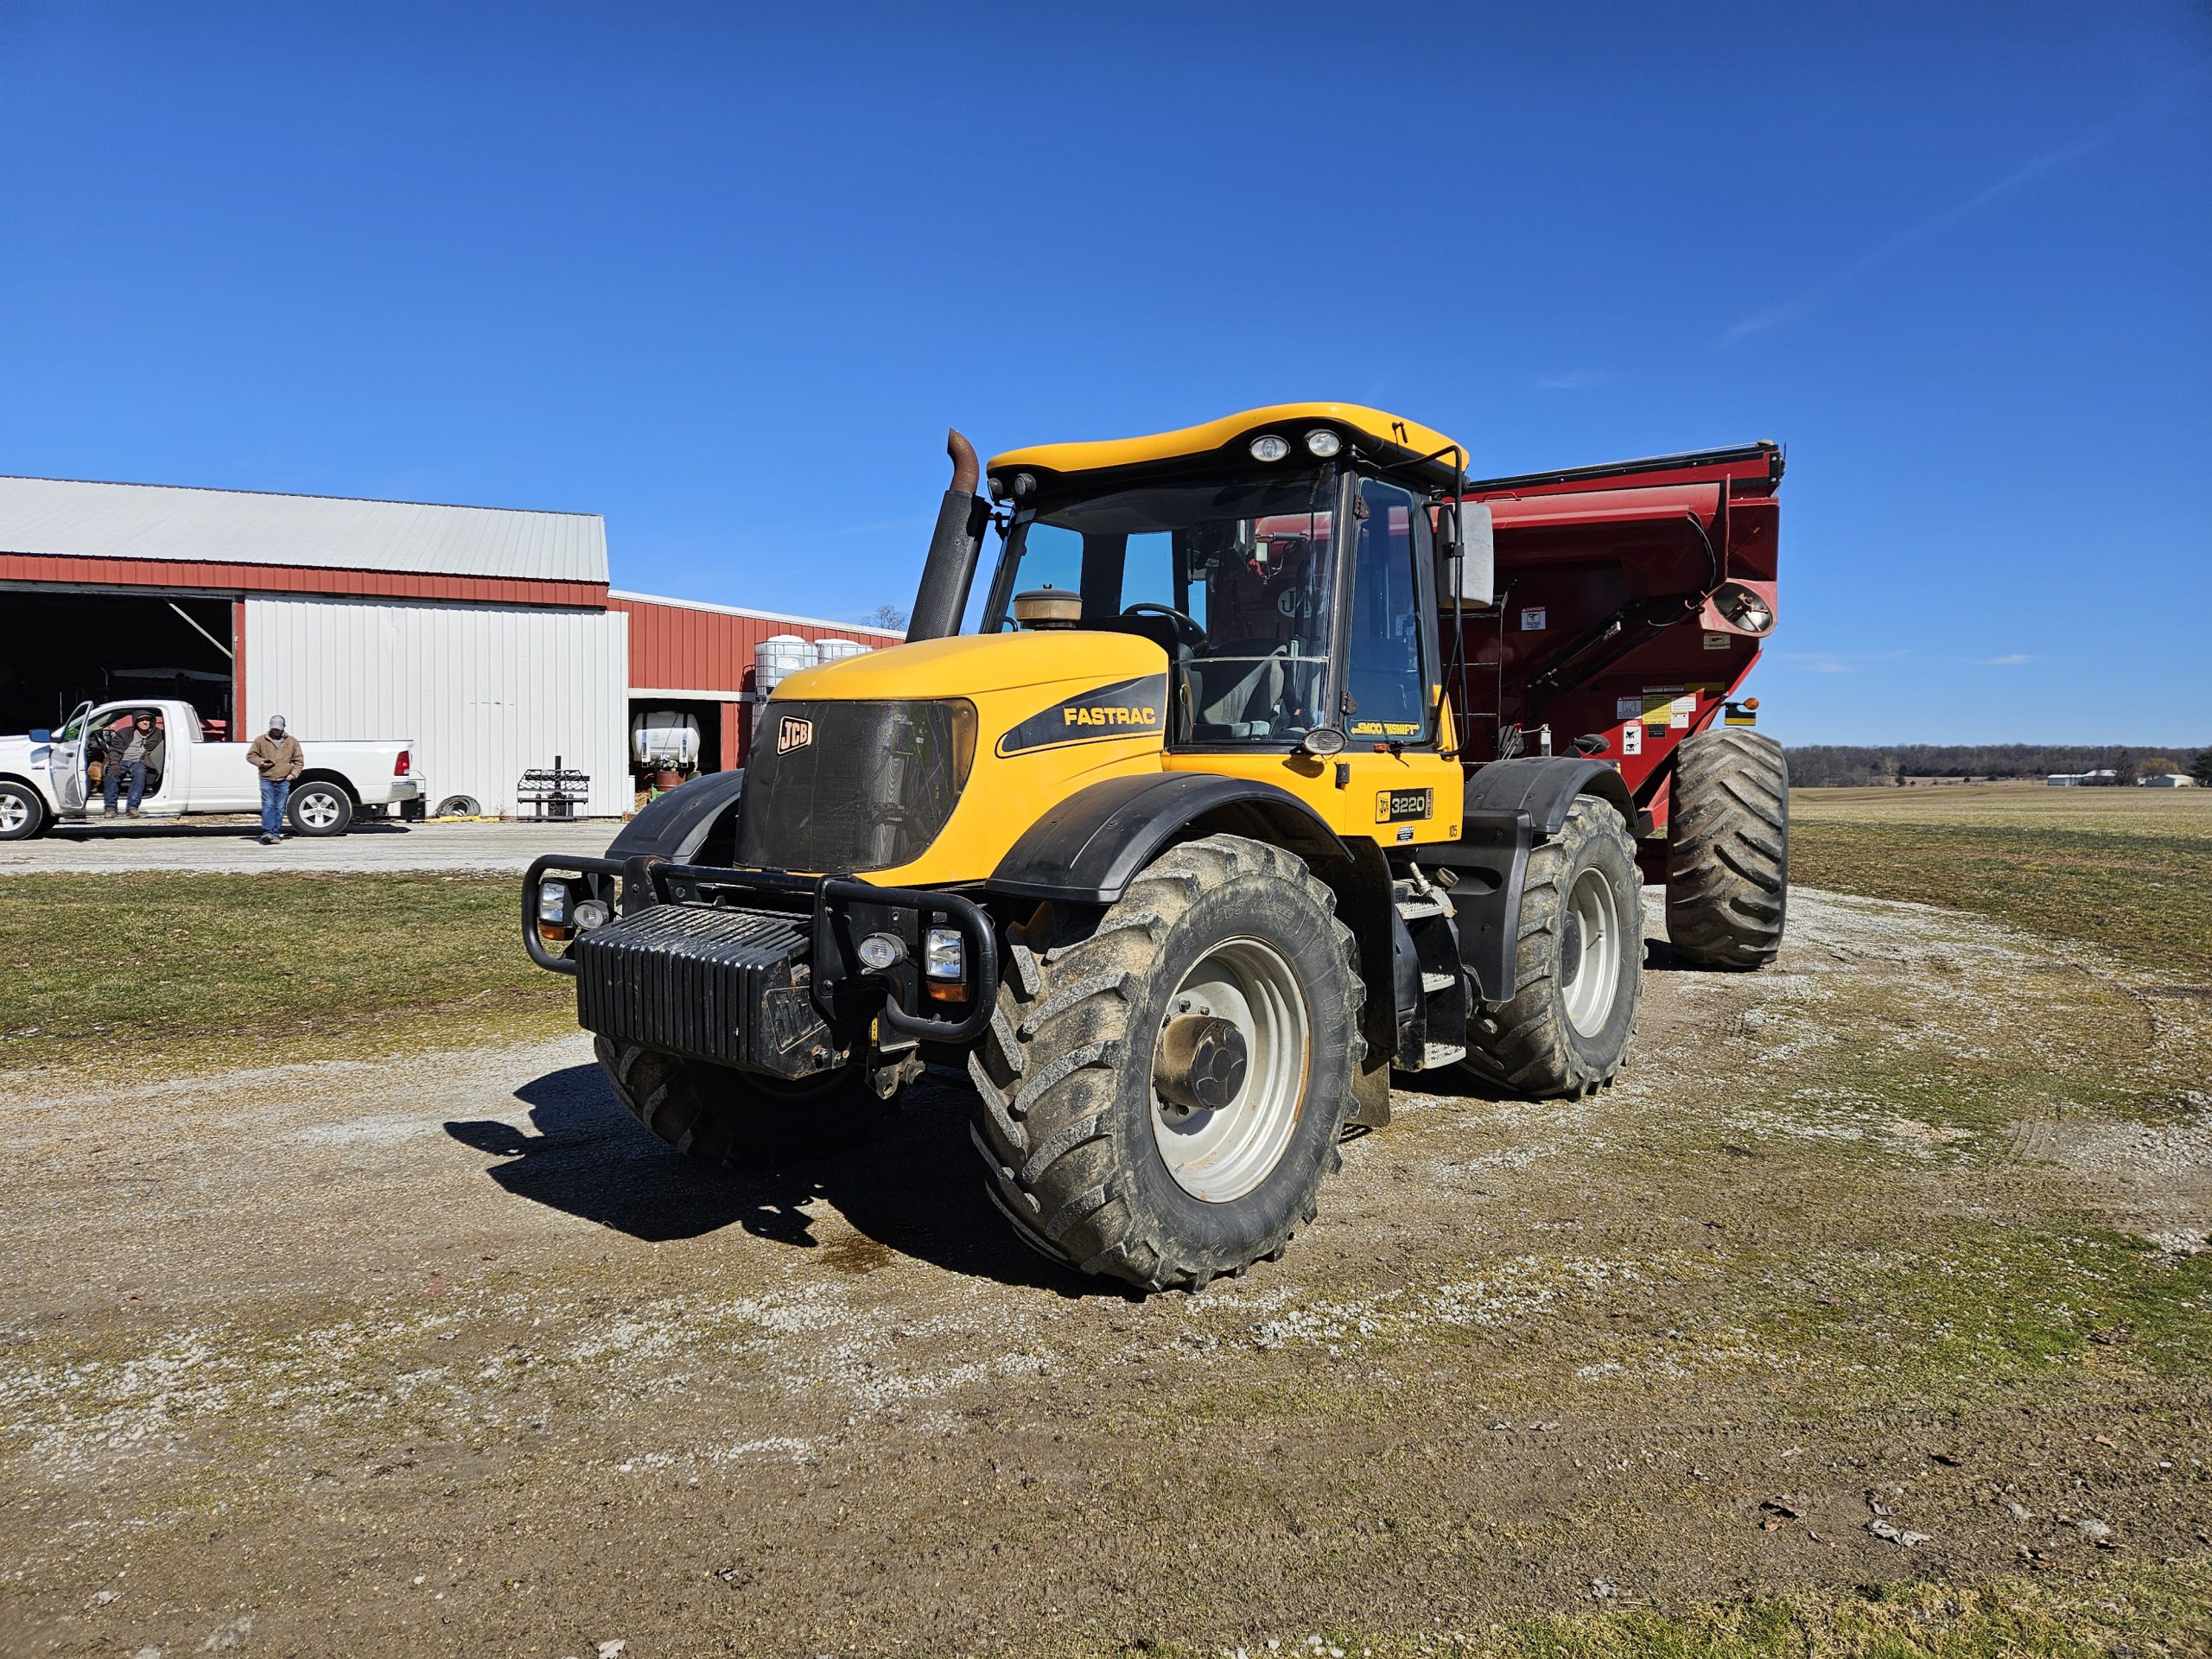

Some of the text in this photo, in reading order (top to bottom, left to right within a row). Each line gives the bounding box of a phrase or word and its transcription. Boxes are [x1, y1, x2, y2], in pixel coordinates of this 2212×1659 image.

[1065, 708, 1156, 725] FASTRAC
[781, 721, 808, 749] JCB
[1391, 796, 1425, 813] 3220
